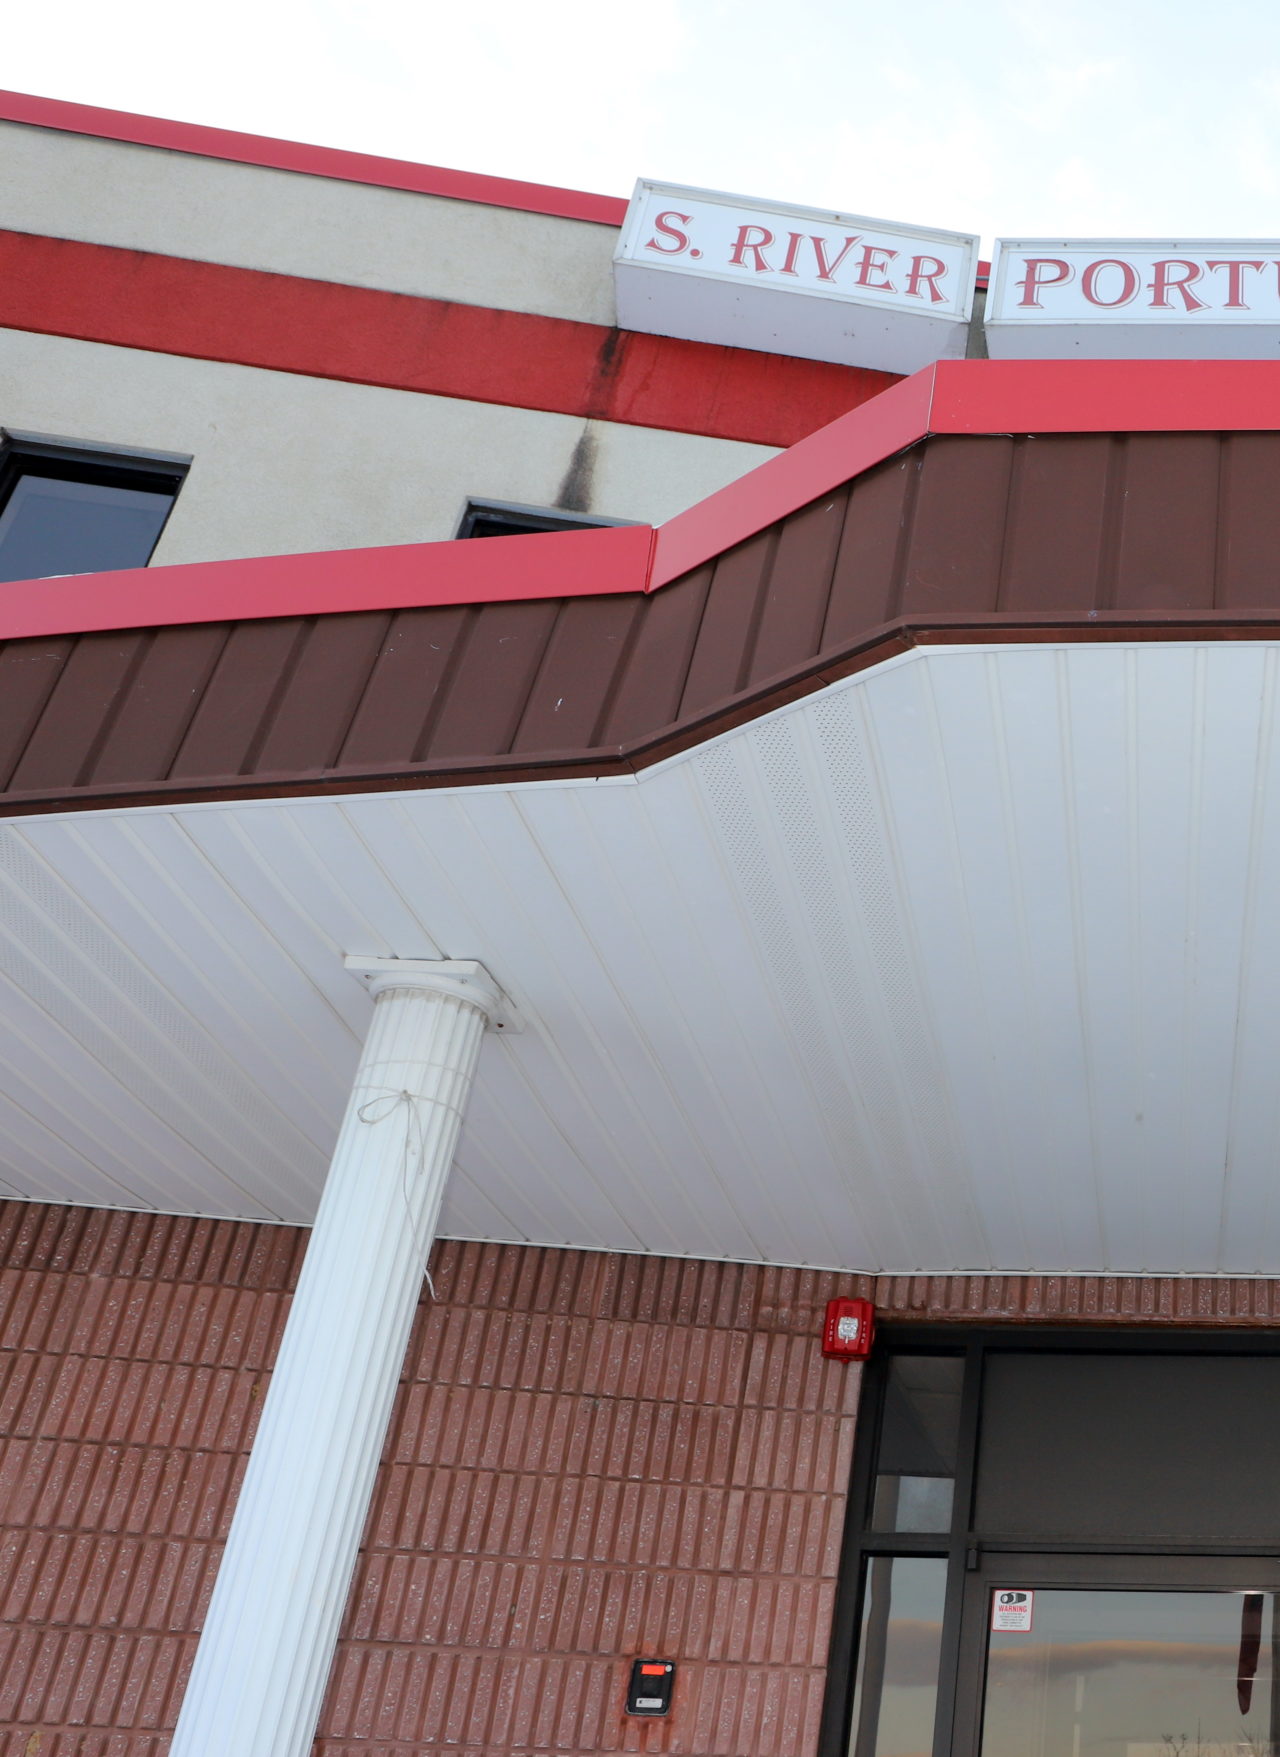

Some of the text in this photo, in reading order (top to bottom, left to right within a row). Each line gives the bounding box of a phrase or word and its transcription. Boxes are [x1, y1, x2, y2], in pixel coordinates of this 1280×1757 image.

[645, 210, 949, 304] S. RIVER
[998, 1605, 1028, 1613] WARNING
